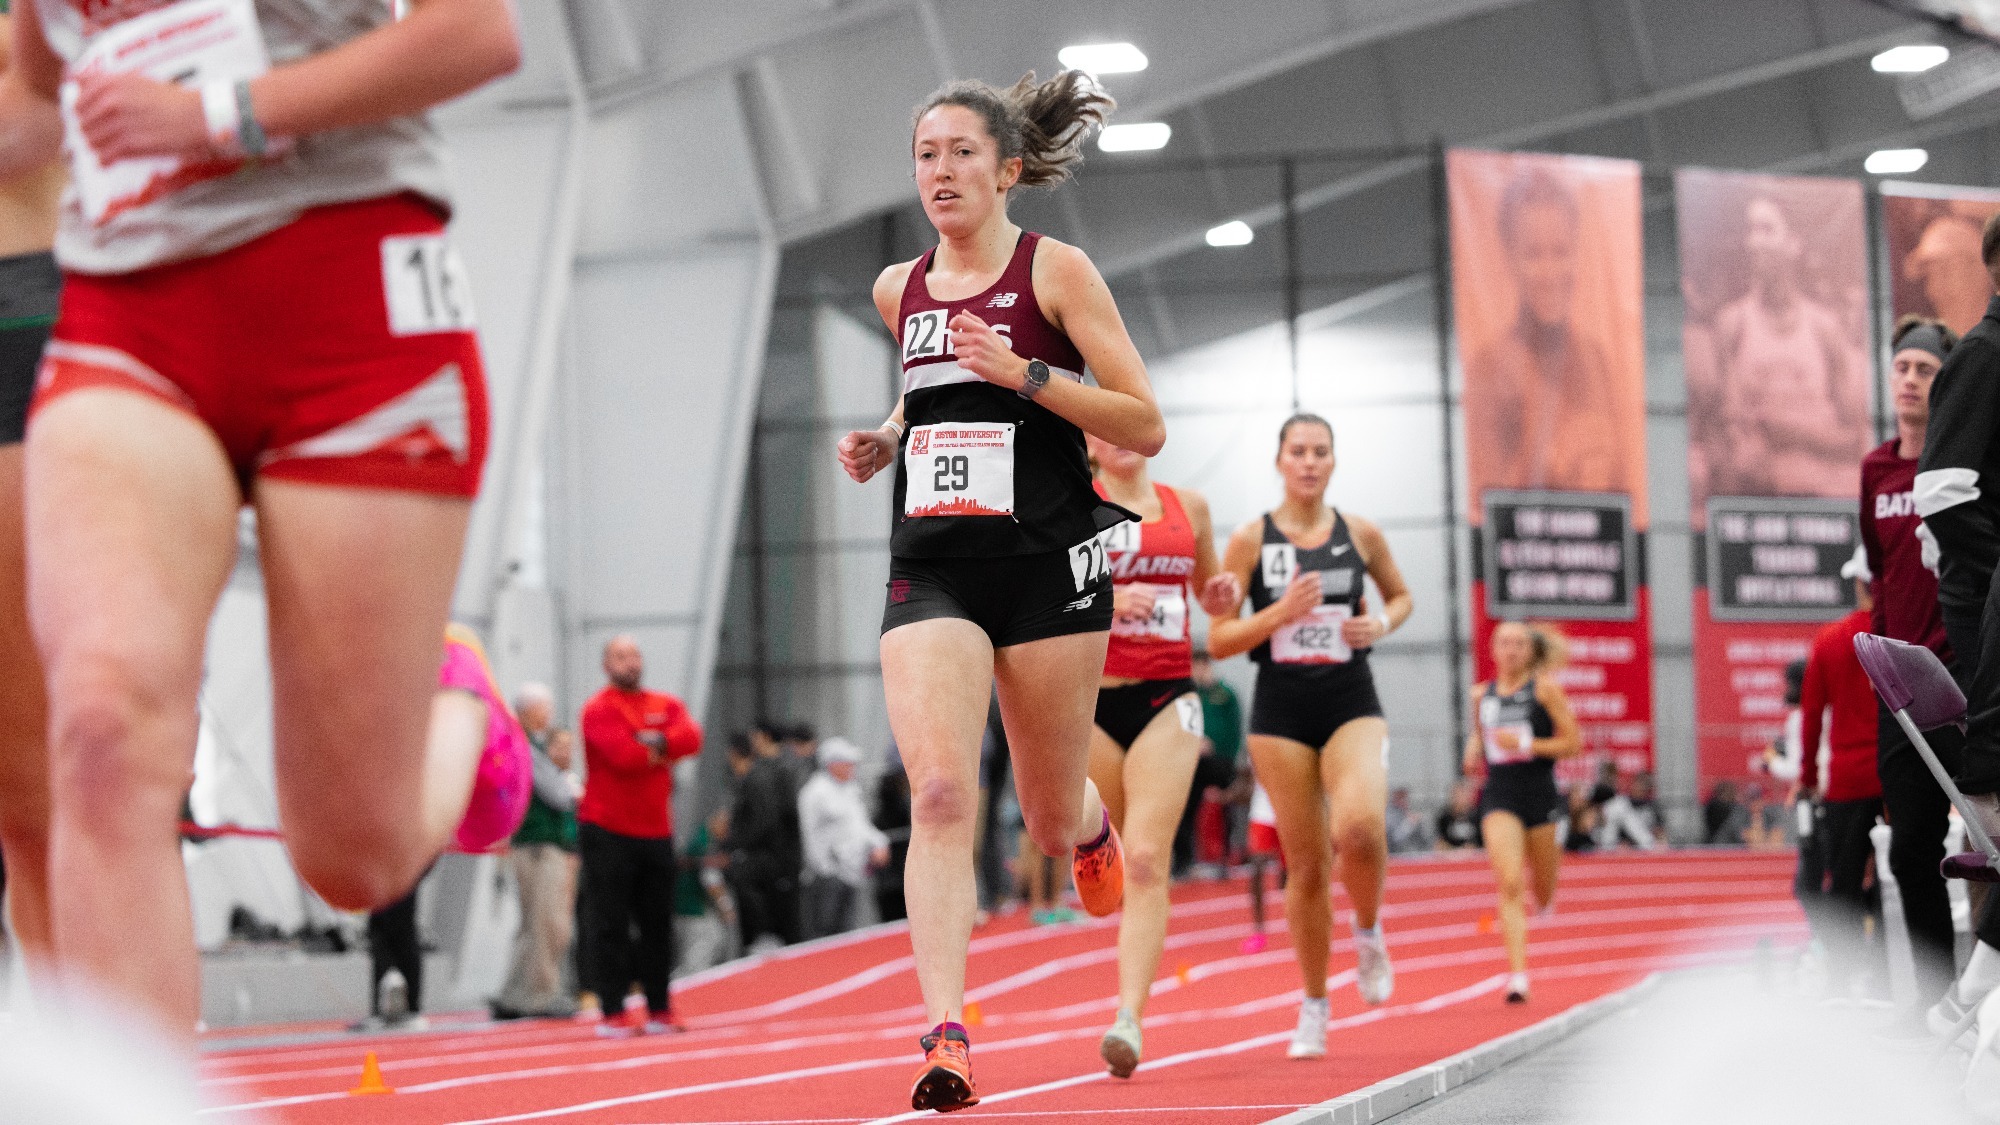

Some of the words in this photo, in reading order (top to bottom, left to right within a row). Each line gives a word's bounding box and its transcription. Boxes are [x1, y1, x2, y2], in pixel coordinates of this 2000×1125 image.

[906, 313, 938, 358] 22
[934, 431, 958, 440] BOSTON
[959, 430, 1004, 439] UNIVERSITY
[934, 455, 969, 492] 29
[1875, 491, 1918, 520] BAT
[1104, 523, 1131, 548] 21
[1078, 538, 1111, 588] 22
[1270, 550, 1288, 579] 4
[1292, 625, 1332, 649] 422
